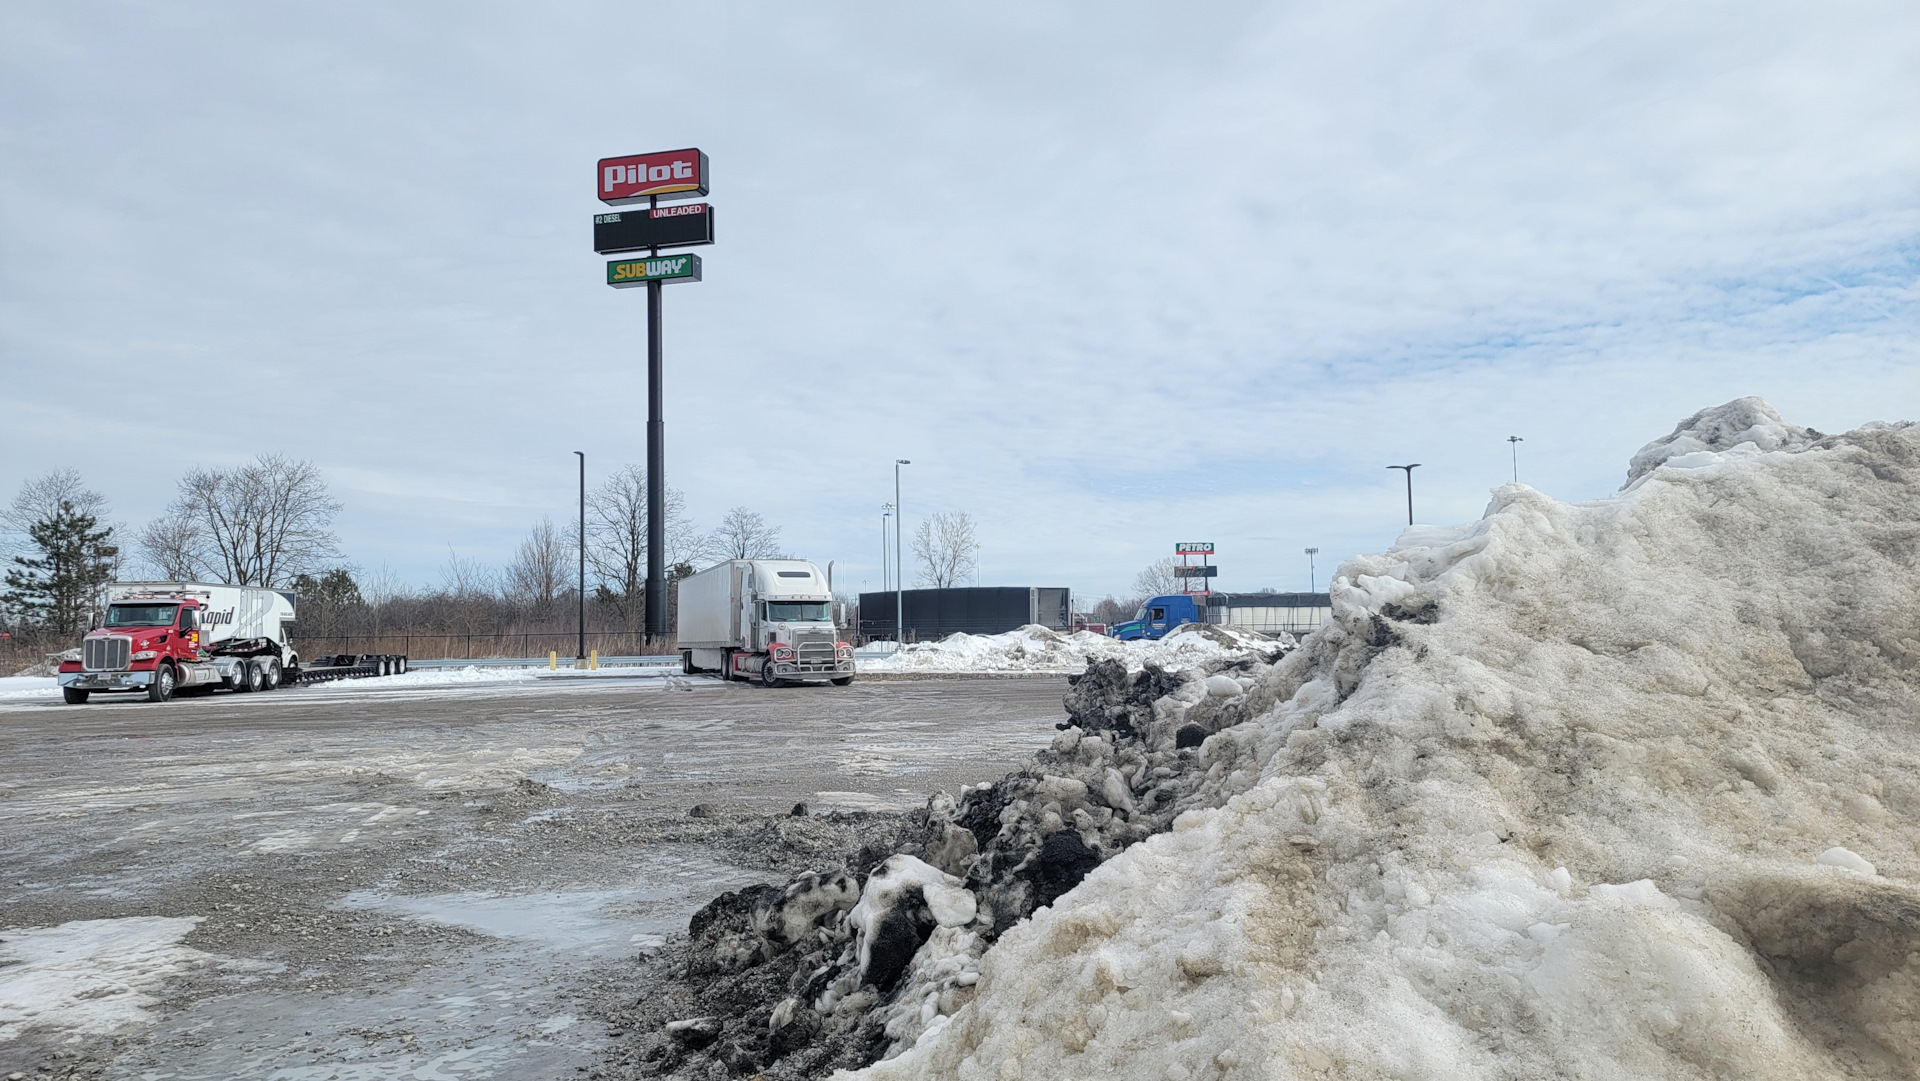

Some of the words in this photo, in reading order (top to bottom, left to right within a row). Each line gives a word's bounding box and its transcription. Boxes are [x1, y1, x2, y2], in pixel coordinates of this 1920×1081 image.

[604, 161, 692, 192] Pilot
[653, 205, 702, 218] UNLEADED
[595, 216, 603, 224] #2
[603, 214, 621, 223] DIESEL
[614, 258, 687, 280] SUBWAY
[1179, 543, 1211, 551] PETRO
